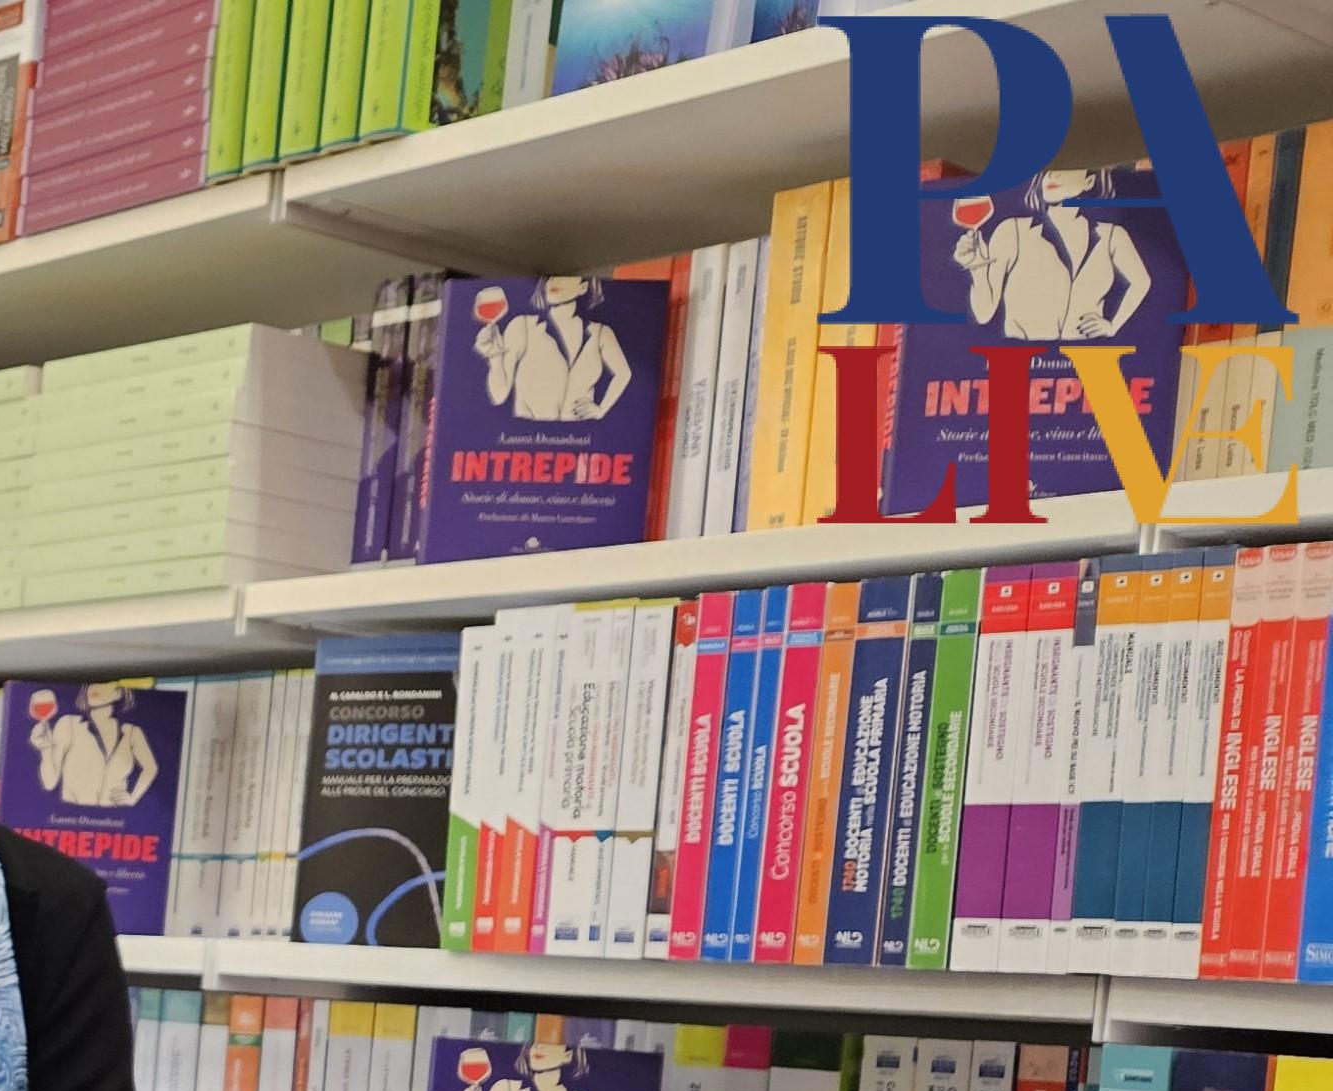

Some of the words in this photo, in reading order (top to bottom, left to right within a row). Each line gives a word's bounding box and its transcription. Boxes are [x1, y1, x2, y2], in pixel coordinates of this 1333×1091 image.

[451, 450, 633, 485] INTREPIDE
[327, 723, 454, 745] DIRIGENT
[329, 705, 425, 721] CONCORSO
[578, 681, 595, 754] Educazione
[868, 677, 889, 750] PRIMARIA
[907, 670, 927, 738] MOTORIA
[324, 748, 452, 770] SCOLASTI
[693, 713, 713, 775] SCUOLA
[724, 709, 746, 774] SCUOLA
[753, 744, 768, 790] SCUOLA
[778, 702, 808, 788] SCUOLA
[851, 694, 874, 787] EDUCAZIONE
[942, 710, 962, 790] SECONDARIE
[1220, 732, 1242, 809] INGLESE
[1259, 714, 1282, 791] INGLESE
[1295, 714, 1319, 791] INGLESE
[684, 777, 706, 846] DOCENTI
[715, 777, 739, 846] DOCENTI
[863, 750, 881, 807] SCUOLA
[901, 739, 921, 818] EDUCAZIONE
[769, 790, 796, 881] Concorso
[844, 797, 864, 863] DOCENTI
[937, 791, 953, 845] SCUOLE
[853, 828, 873, 893] MOTORIA
[895, 823, 911, 887] DOCENTI
